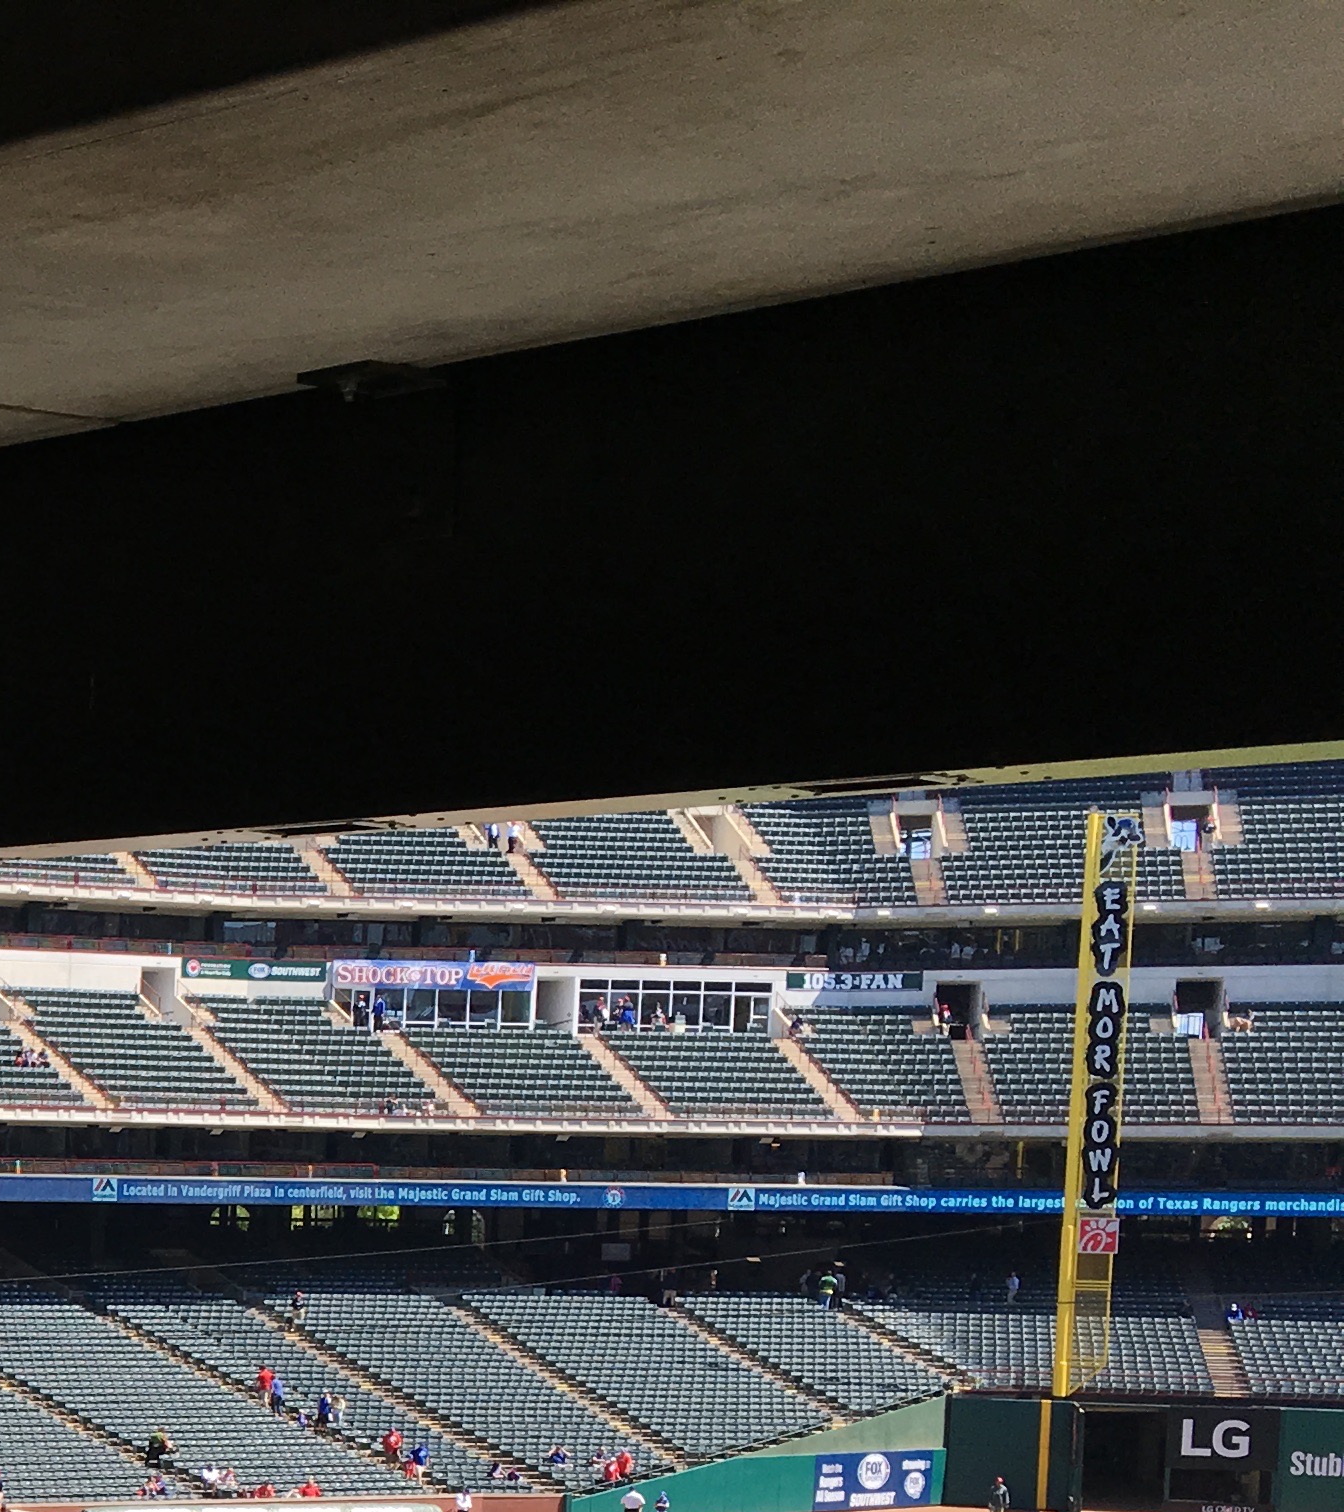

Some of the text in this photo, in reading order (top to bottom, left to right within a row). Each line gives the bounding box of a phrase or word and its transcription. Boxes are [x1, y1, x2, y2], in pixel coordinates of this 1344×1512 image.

[1100, 888, 1120, 970] EAT
[337, 963, 464, 985] SHOCK TOP
[803, 973, 853, 990] 105.3
[860, 974, 904, 990] FAN
[1095, 989, 1119, 1072] MOR
[1088, 1089, 1113, 1204] FOWL
[123, 1184, 164, 1197] Located
[168, 1185, 178, 1197] in
[181, 1185, 241, 1200] Vandergriff
[244, 1186, 271, 1198] Plaza
[275, 1186, 285, 1198] in
[350, 1188, 372, 1200] visit
[375, 1188, 395, 1200] the
[398, 1188, 448, 1203] Majestic
[452, 1189, 486, 1201] Grand
[490, 1190, 518, 1202] Slam
[522, 1190, 545, 1202] Gift
[548, 1190, 581, 1205] Shop.
[758, 1193, 808, 1209] Majestic
[811, 1194, 845, 1207] Grand
[849, 1194, 877, 1207] Slam
[881, 1195, 903, 1207] Gift
[906, 1196, 936, 1210] Shop
[941, 1195, 987, 1208] carries
[992, 1195, 1014, 1209] the
[1138, 1196, 1155, 1210] of
[1158, 1198, 1199, 1210] Texas
[1203, 1198, 1261, 1213] Rangers
[1180, 1418, 1251, 1458] LG
[865, 1461, 883, 1476] FOX
[1290, 1451, 1344, 1477] Stub
[850, 1492, 896, 1507] SOUTHWEST
